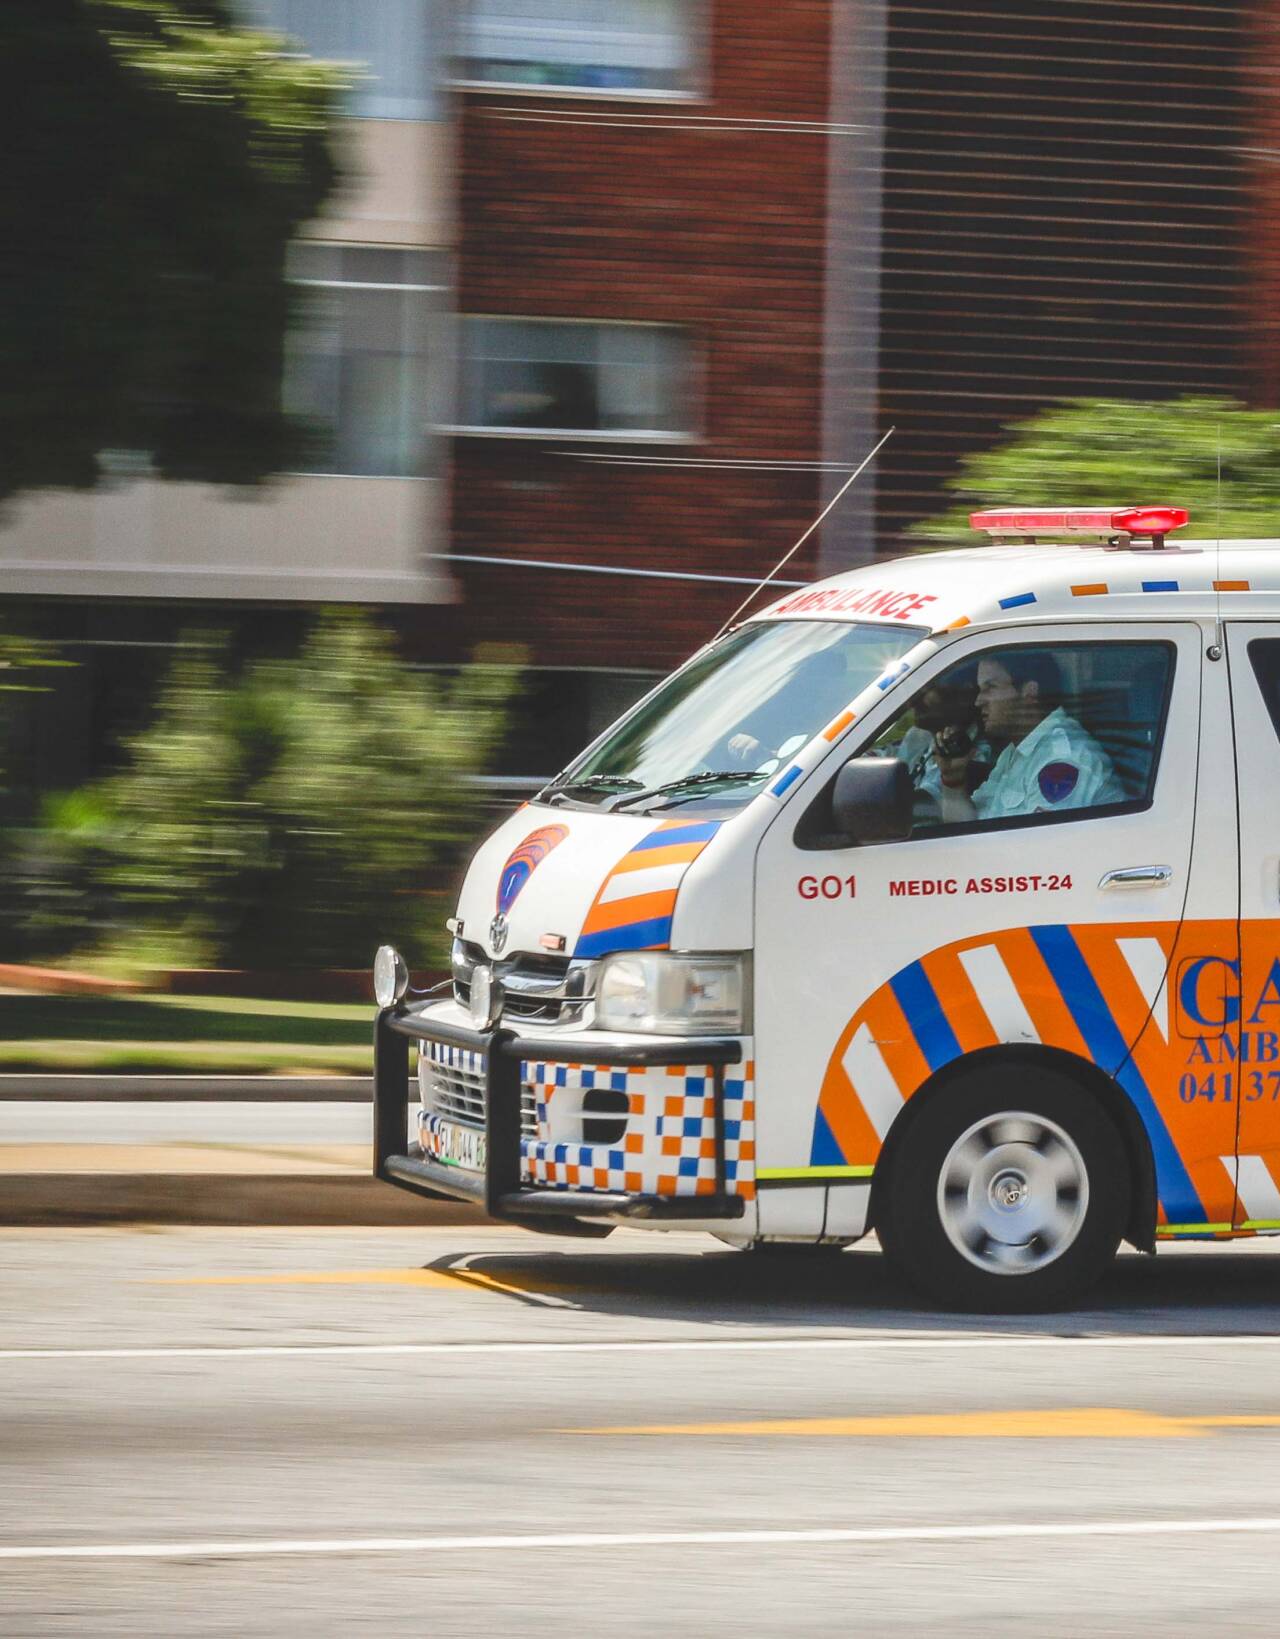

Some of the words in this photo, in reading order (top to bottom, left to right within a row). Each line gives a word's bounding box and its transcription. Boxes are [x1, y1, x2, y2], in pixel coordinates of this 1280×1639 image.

[768, 588, 939, 620] AMBULANCE
[889, 880, 958, 897] MEDIC
[965, 874, 1073, 894] ASSIST-24
[1179, 1072, 1234, 1104] 041
